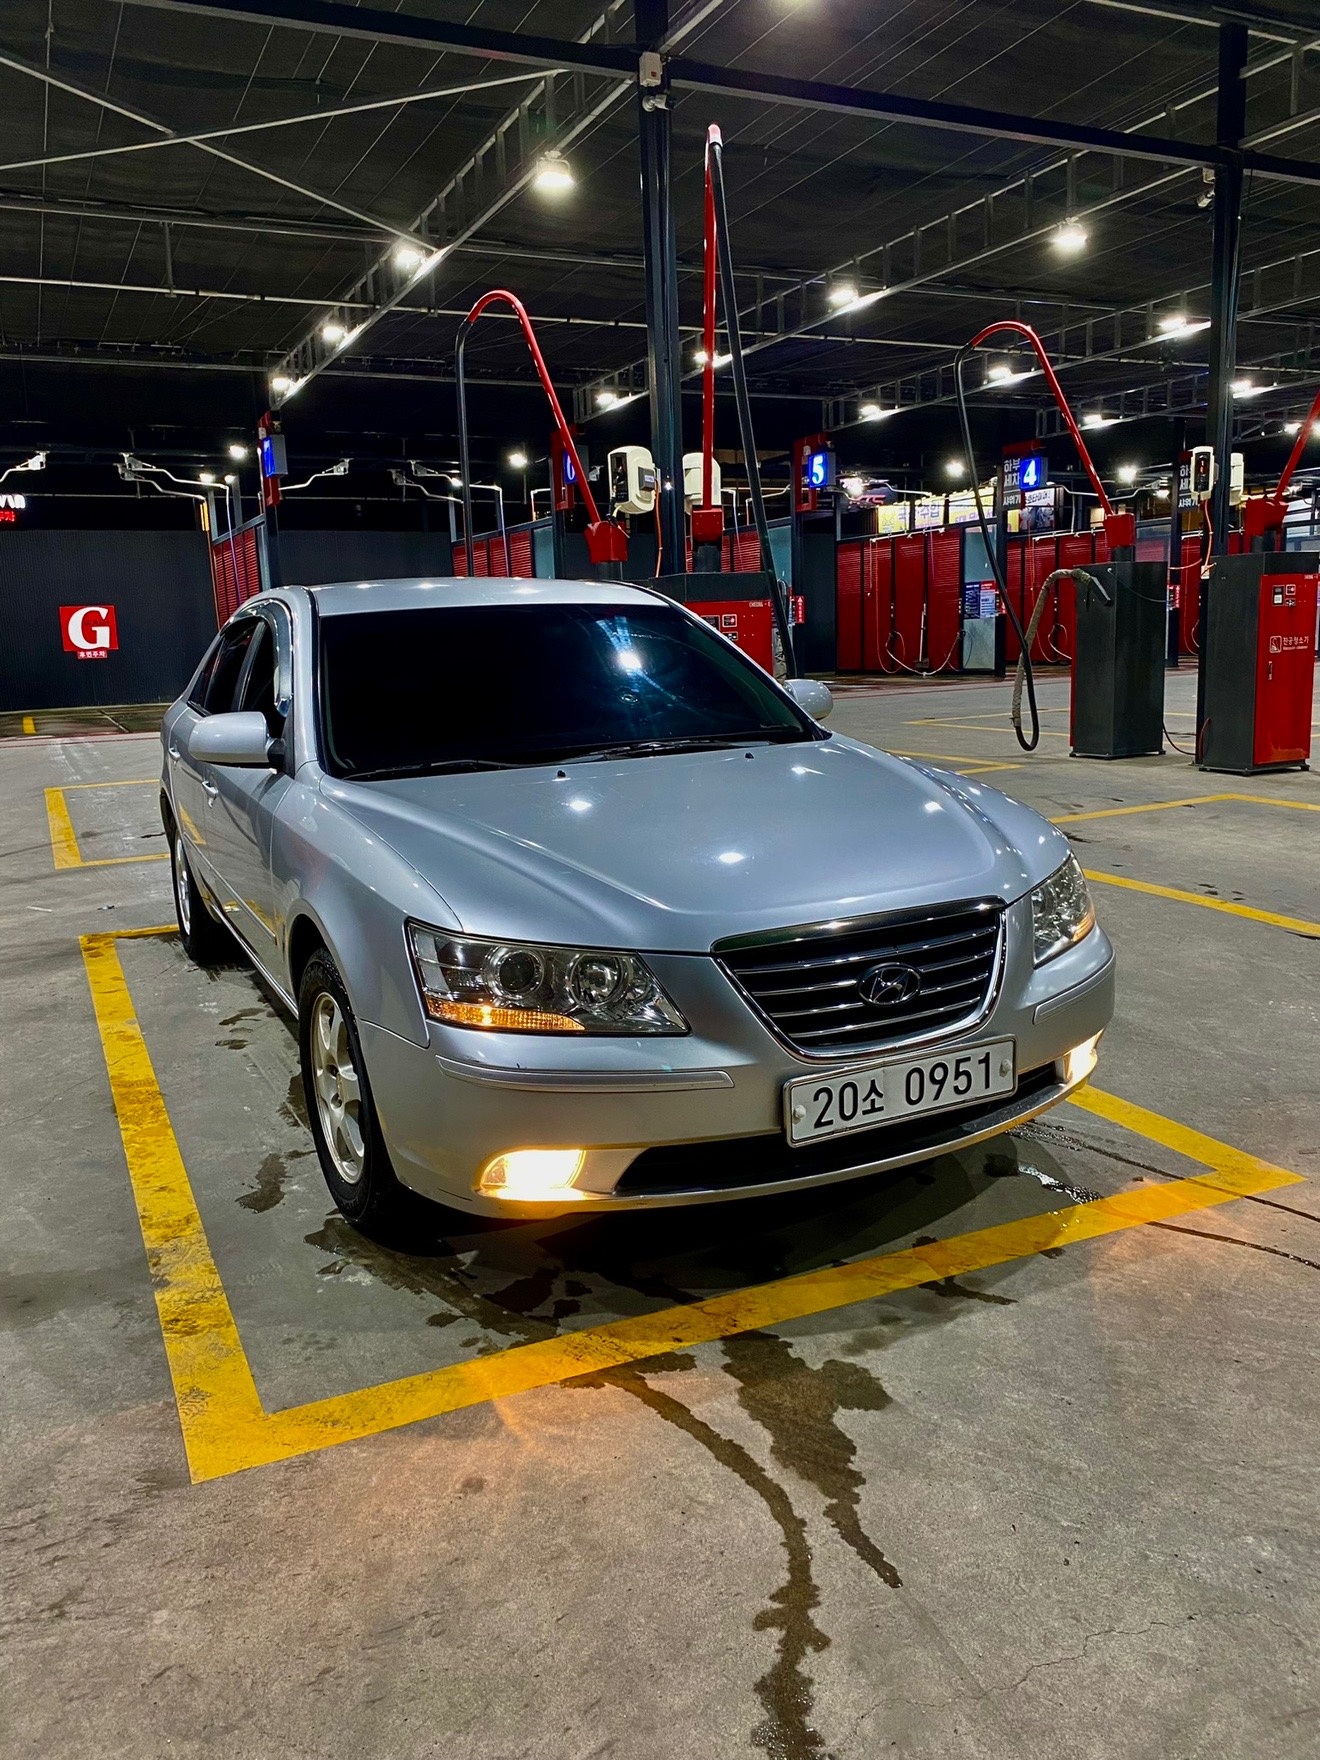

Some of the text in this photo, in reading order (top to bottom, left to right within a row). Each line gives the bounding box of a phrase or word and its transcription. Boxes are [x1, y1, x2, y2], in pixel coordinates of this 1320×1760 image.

[811, 455, 824, 484] 5
[1003, 458, 1021, 472] 하부
[1023, 459, 1037, 486] 4
[1003, 472, 1020, 487] 세차
[68, 606, 110, 650] G
[1282, 636, 1309, 646] 진공청소기
[812, 1052, 991, 1129] 20소 0951
